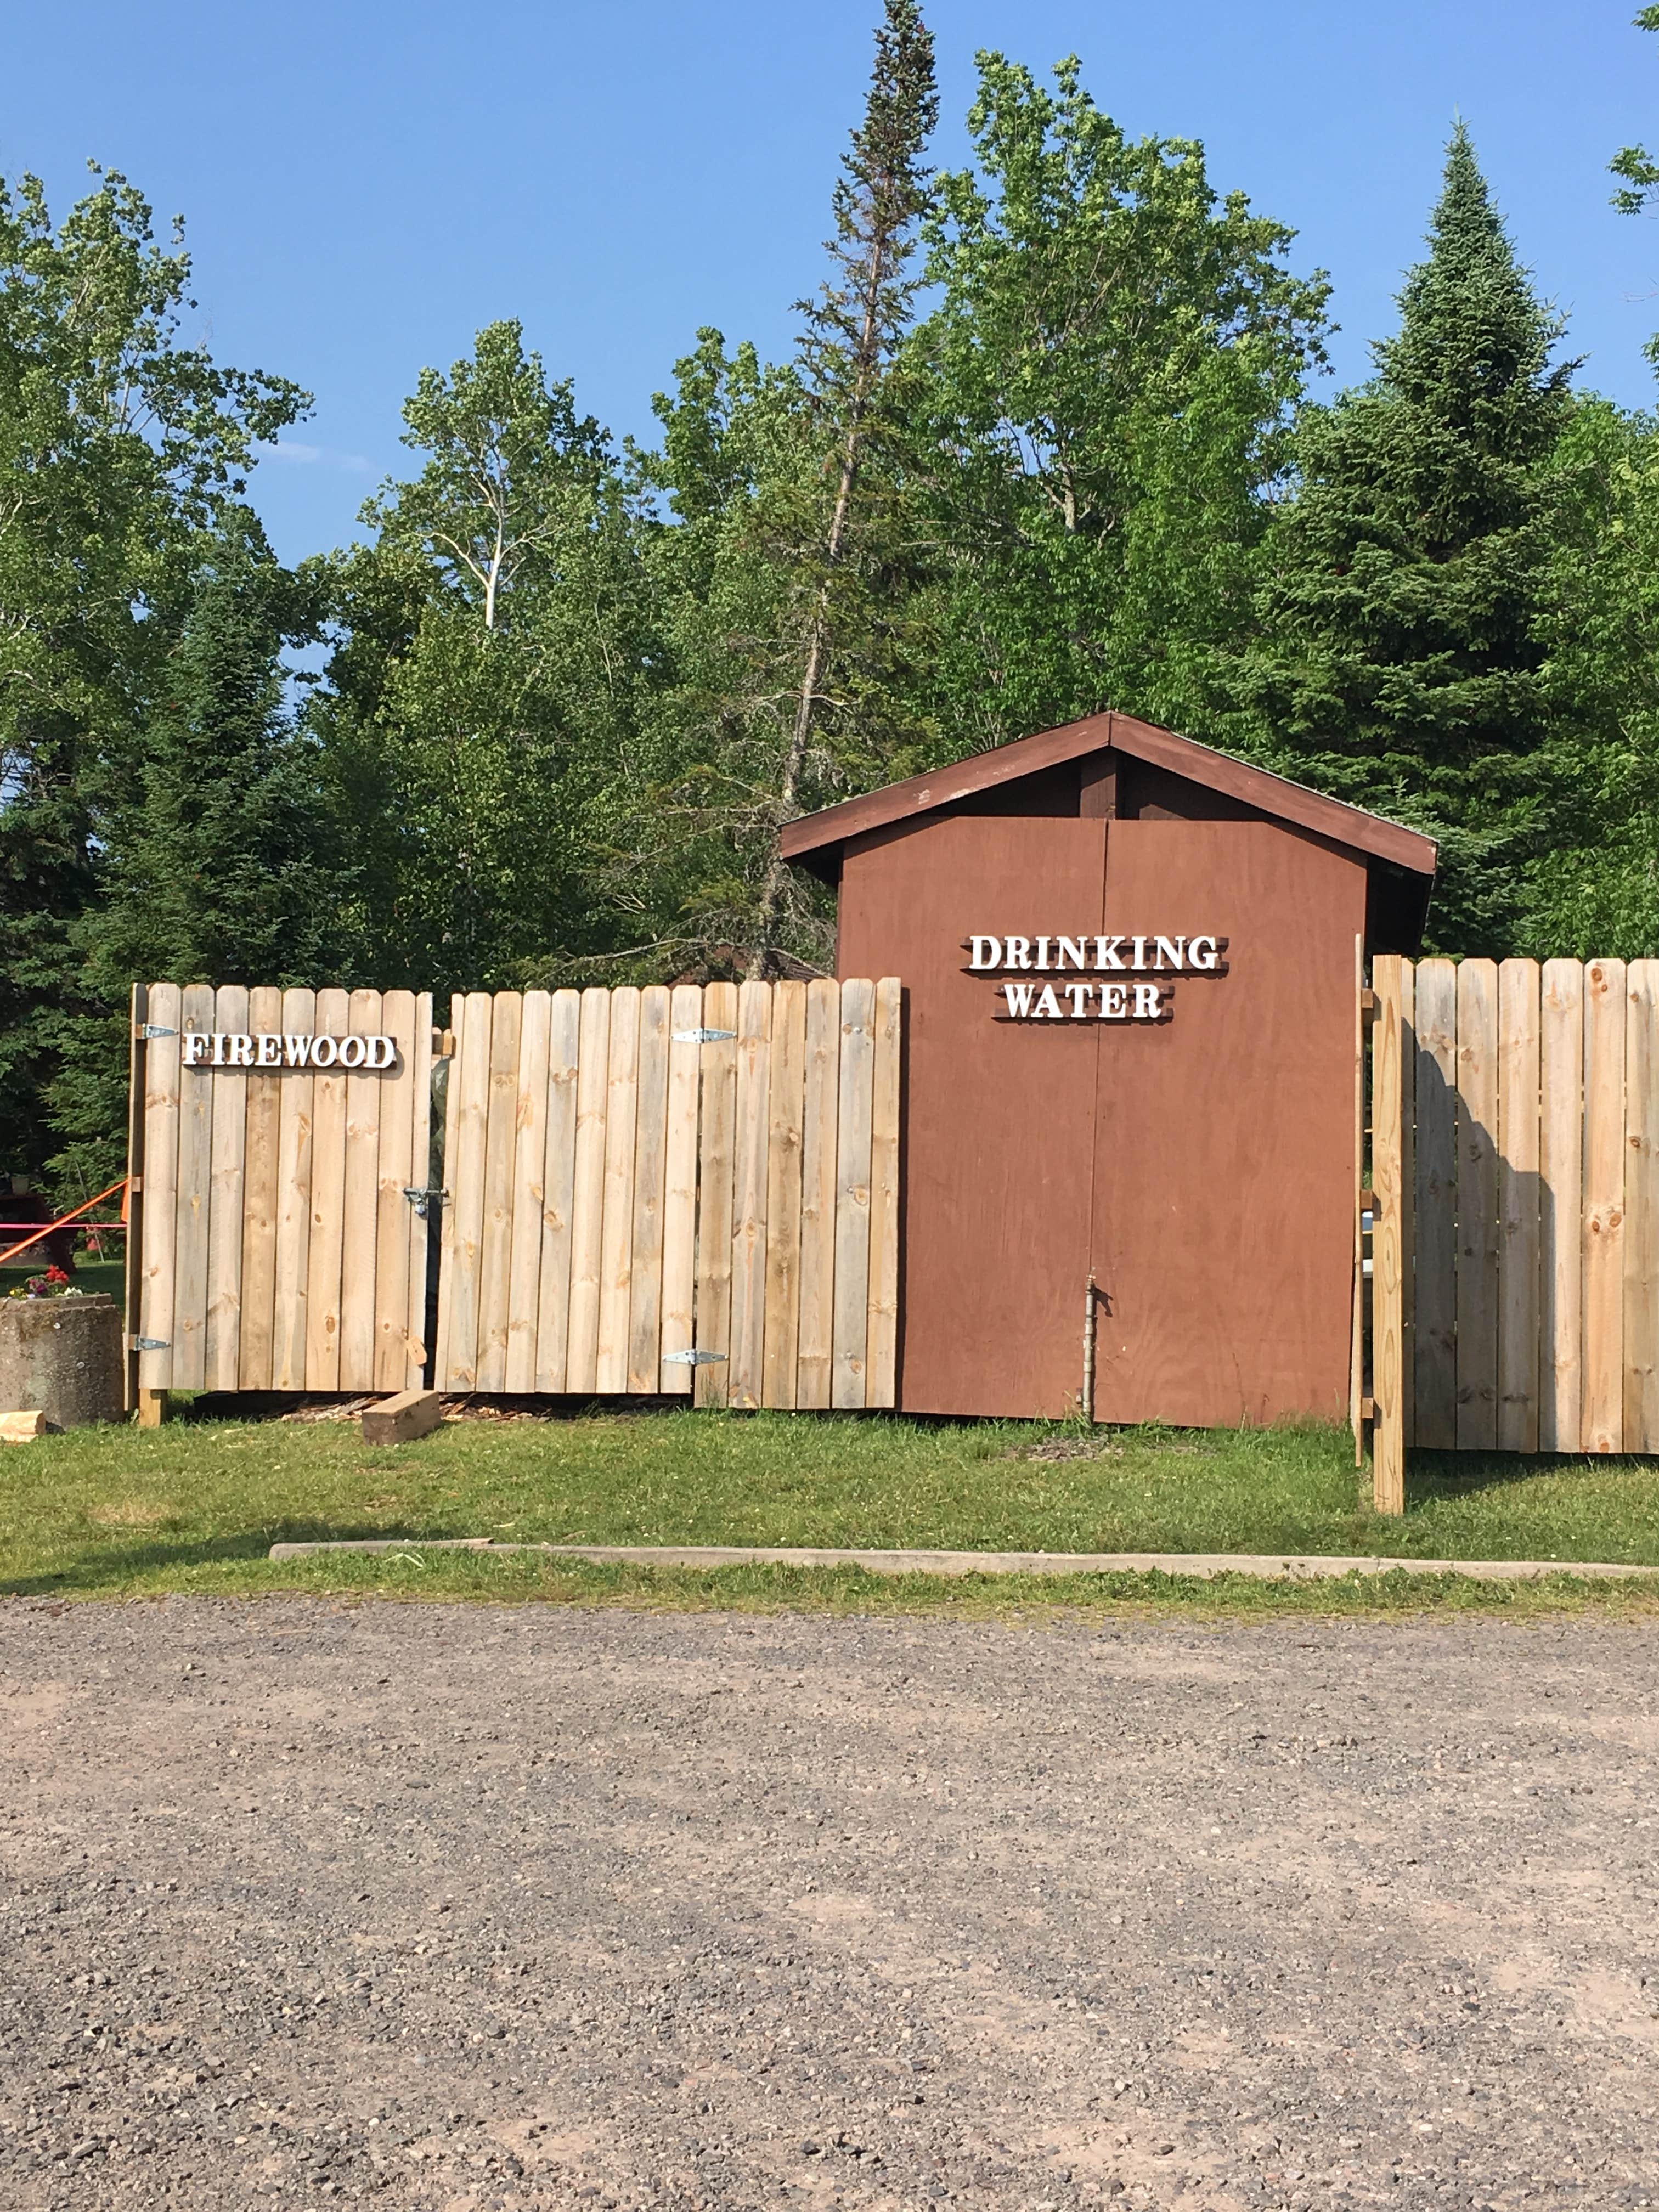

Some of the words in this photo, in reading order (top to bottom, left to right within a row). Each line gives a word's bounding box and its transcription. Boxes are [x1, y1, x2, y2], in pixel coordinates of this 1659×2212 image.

[969, 935, 1218, 970] DRINKING
[1003, 984, 1161, 1018] WATER
[182, 1033, 395, 1069] FIREWOOD
